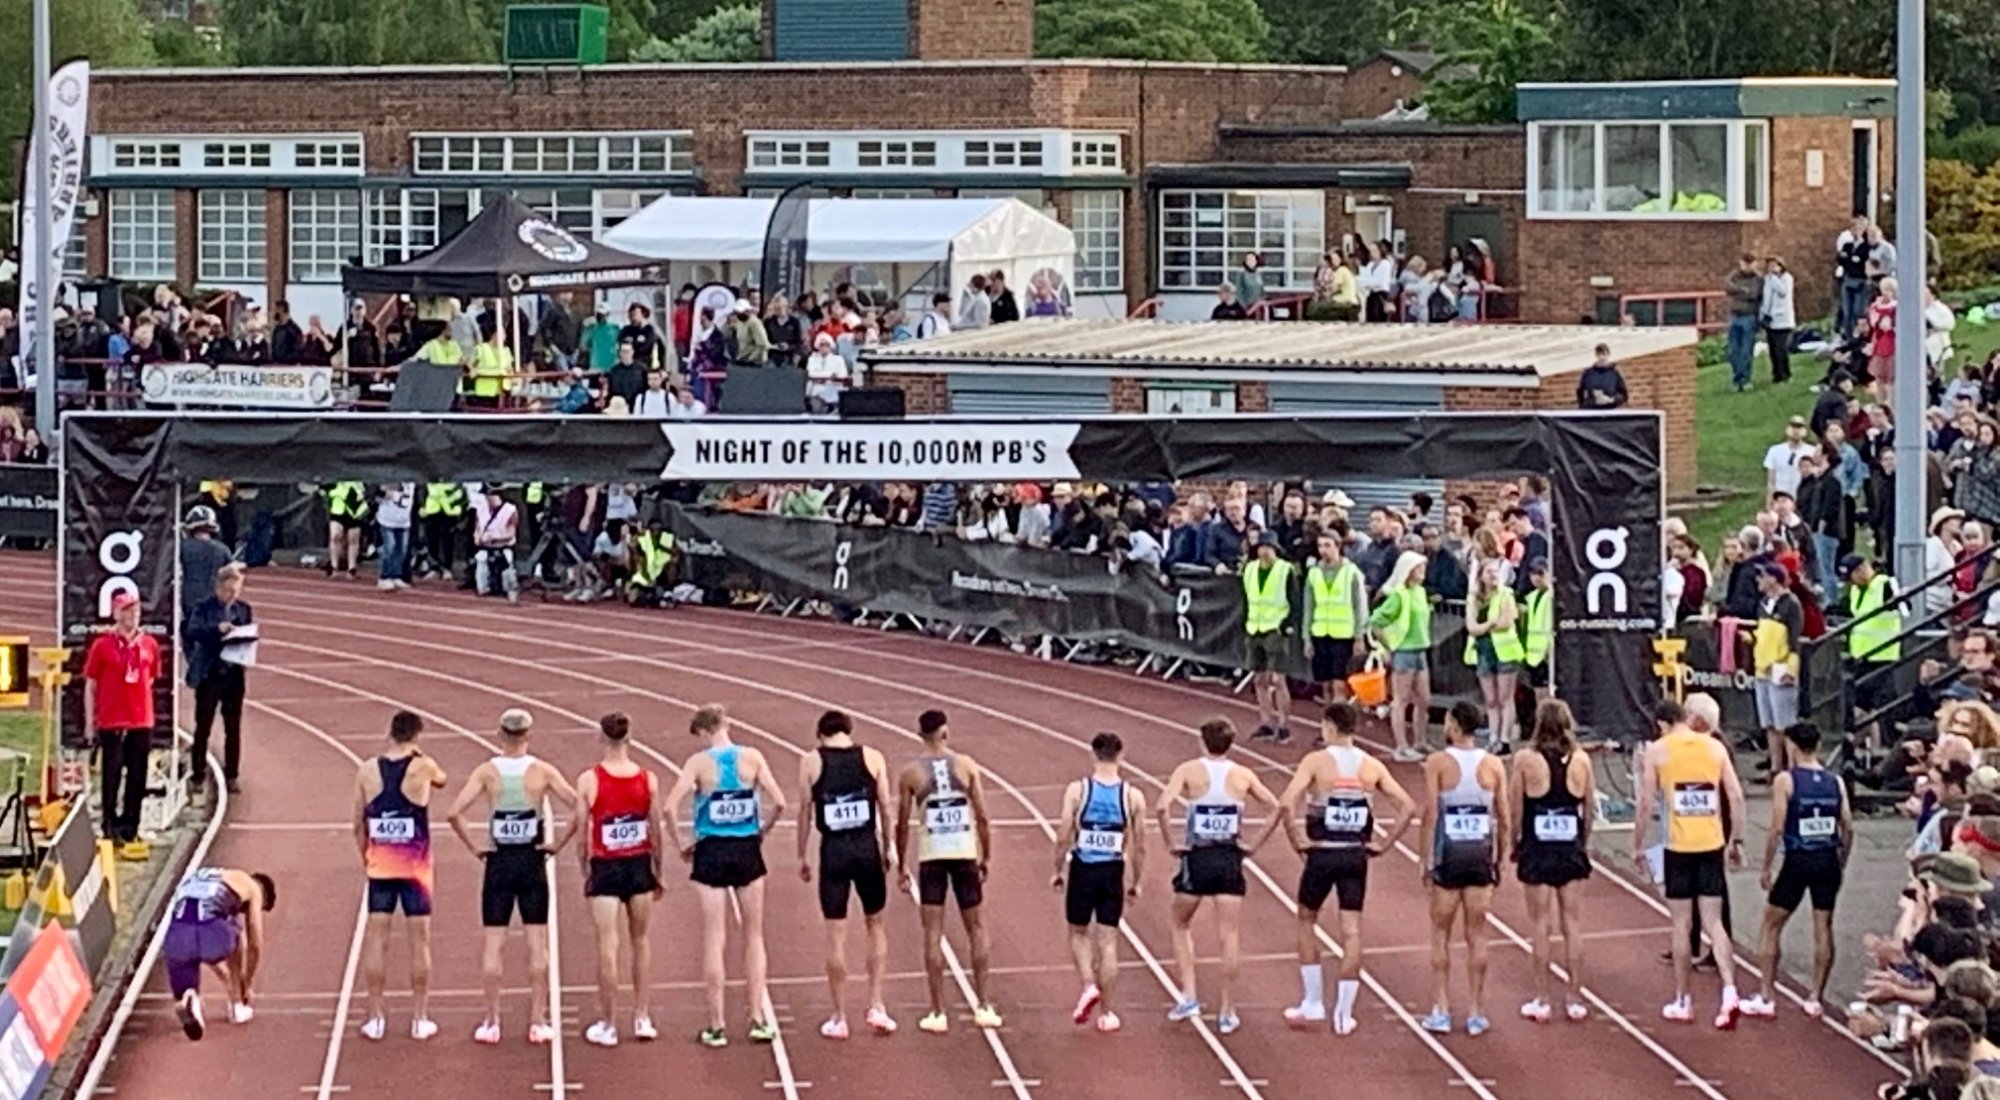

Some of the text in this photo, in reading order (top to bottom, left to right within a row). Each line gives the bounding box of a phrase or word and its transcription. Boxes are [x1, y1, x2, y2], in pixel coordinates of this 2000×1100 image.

[172, 369, 305, 388] HIGHGATE HARRIERS
[696, 439, 1047, 467] NIGHT OF THE 10,000M PB'S
[1559, 618, 1656, 632] on-running.com
[1684, 665, 1732, 687] Dream
[716, 801, 747, 816] 403
[1680, 796, 1709, 808] 404
[833, 805, 859, 821] 411
[934, 809, 962, 824] 410
[1330, 809, 1361, 823] 401
[376, 822, 407, 835] 409
[500, 822, 530, 835] 407
[1201, 817, 1232, 831] 402
[1452, 818, 1480, 832] 412
[1542, 819, 1569, 831] 413
[608, 825, 640, 840] 405
[1085, 832, 1116, 848] 408
